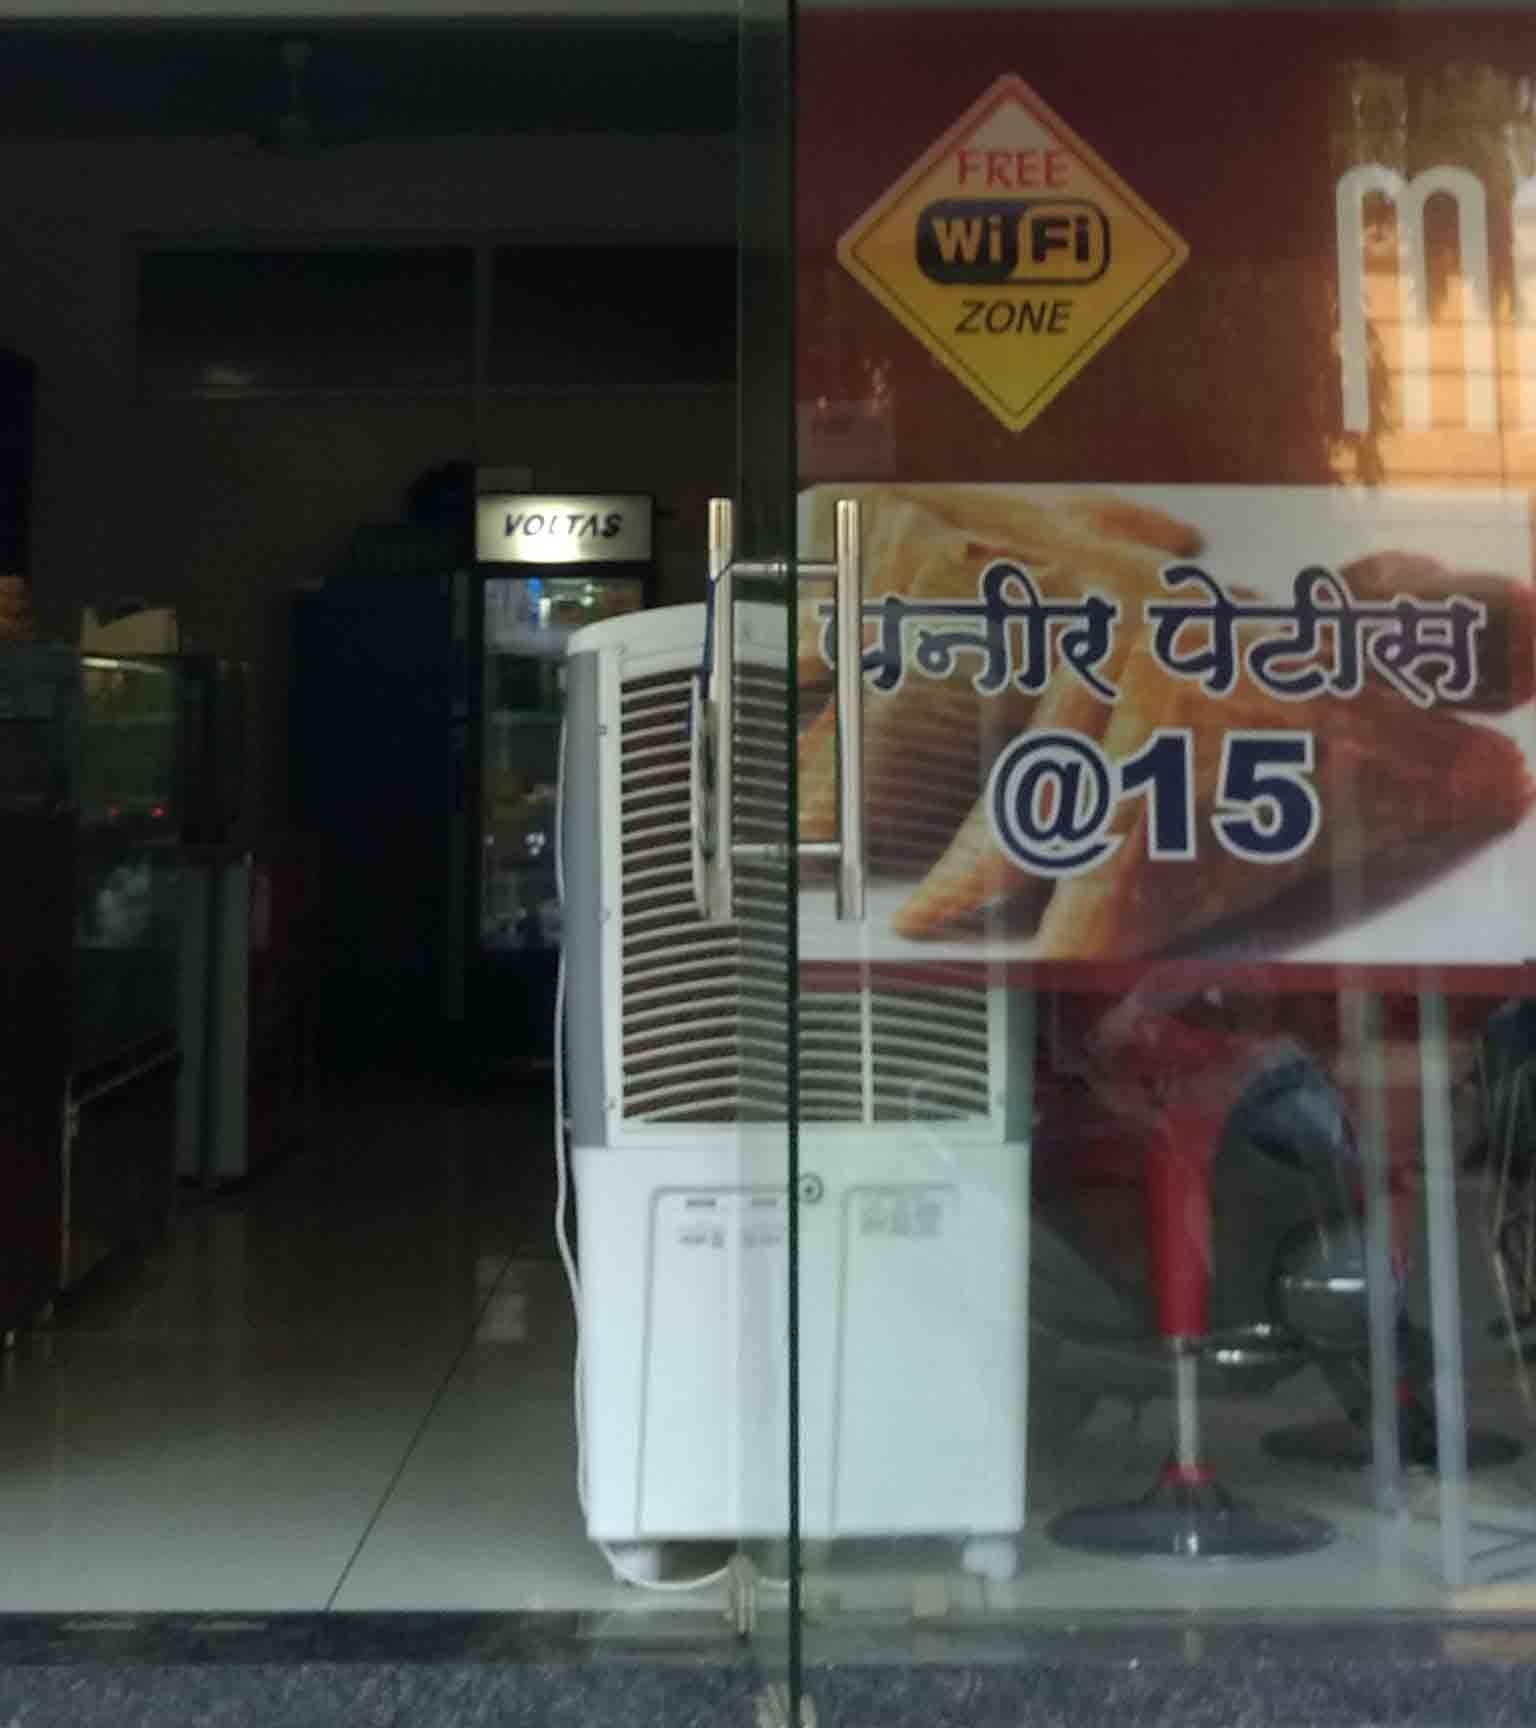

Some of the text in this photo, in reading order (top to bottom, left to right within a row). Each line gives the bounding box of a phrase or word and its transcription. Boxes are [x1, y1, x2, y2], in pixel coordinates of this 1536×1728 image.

[958, 151, 1070, 191] FREE
[955, 301, 1073, 336] ZONE
[818, 560, 1486, 706] पनीर पेटीस
[988, 728, 1320, 877] @15
